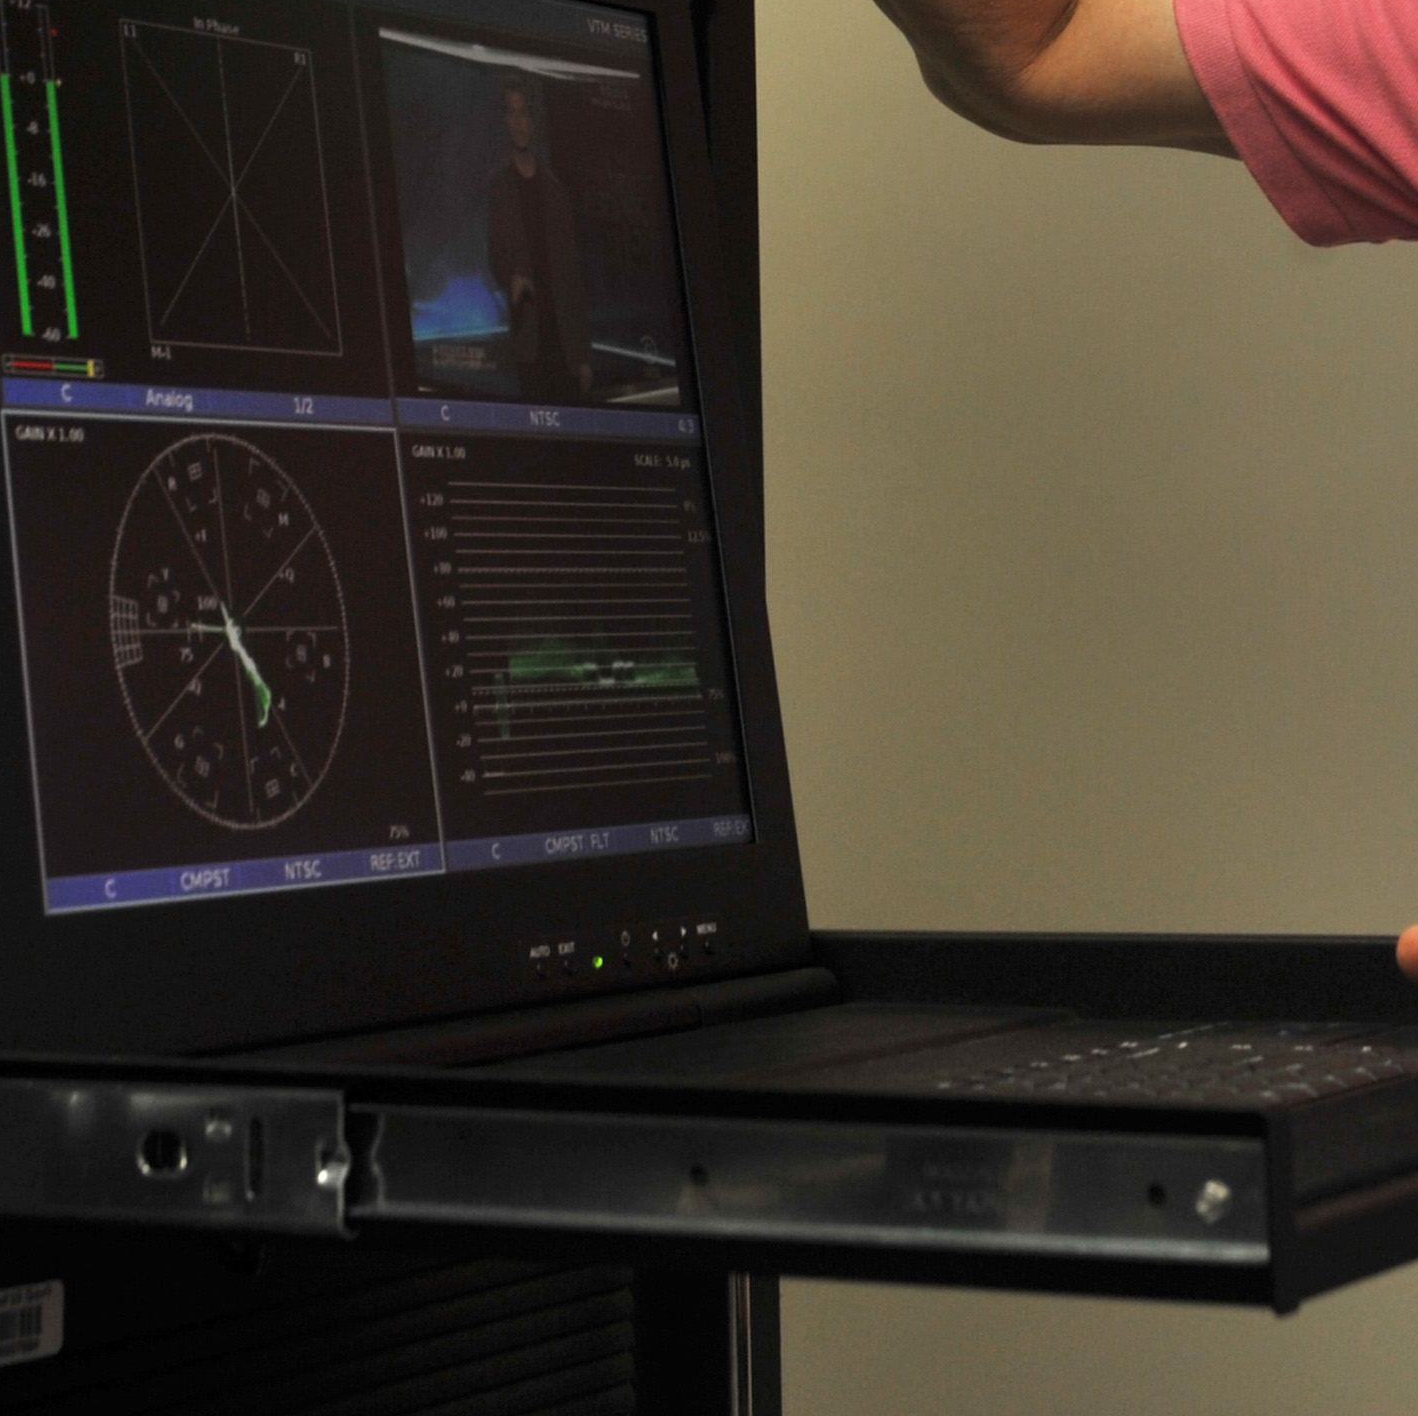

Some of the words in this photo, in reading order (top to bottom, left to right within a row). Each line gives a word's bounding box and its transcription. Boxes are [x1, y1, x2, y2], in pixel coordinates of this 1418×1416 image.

[193, 16, 204, 30] In
[205, 18, 240, 35] Phase
[587, 17, 611, 36] VTM
[613, 23, 648, 44] SERIES
[60, 385, 72, 403] C
[145, 388, 194, 412] Analog
[294, 396, 314, 415] 1/2
[441, 405, 450, 422] C
[529, 410, 562, 428] NTSC
[15, 425, 45, 441] GAIN
[58, 427, 85, 444] 1.00
[412, 444, 436, 459] GAIN
[445, 446, 466, 460] 1.00
[419, 492, 444, 507] +120
[423, 527, 448, 541] +100
[492, 842, 500, 860] C
[545, 835, 583, 854] CMPST
[590, 832, 610, 849] FLT
[650, 826, 680, 844] NTSC
[105, 879, 117, 899] C
[180, 869, 231, 890] CMPST
[284, 859, 322, 880] NTSC
[696, 922, 718, 935] MENU
[529, 945, 551, 959] AUTO
[558, 941, 576, 955] EXIT
